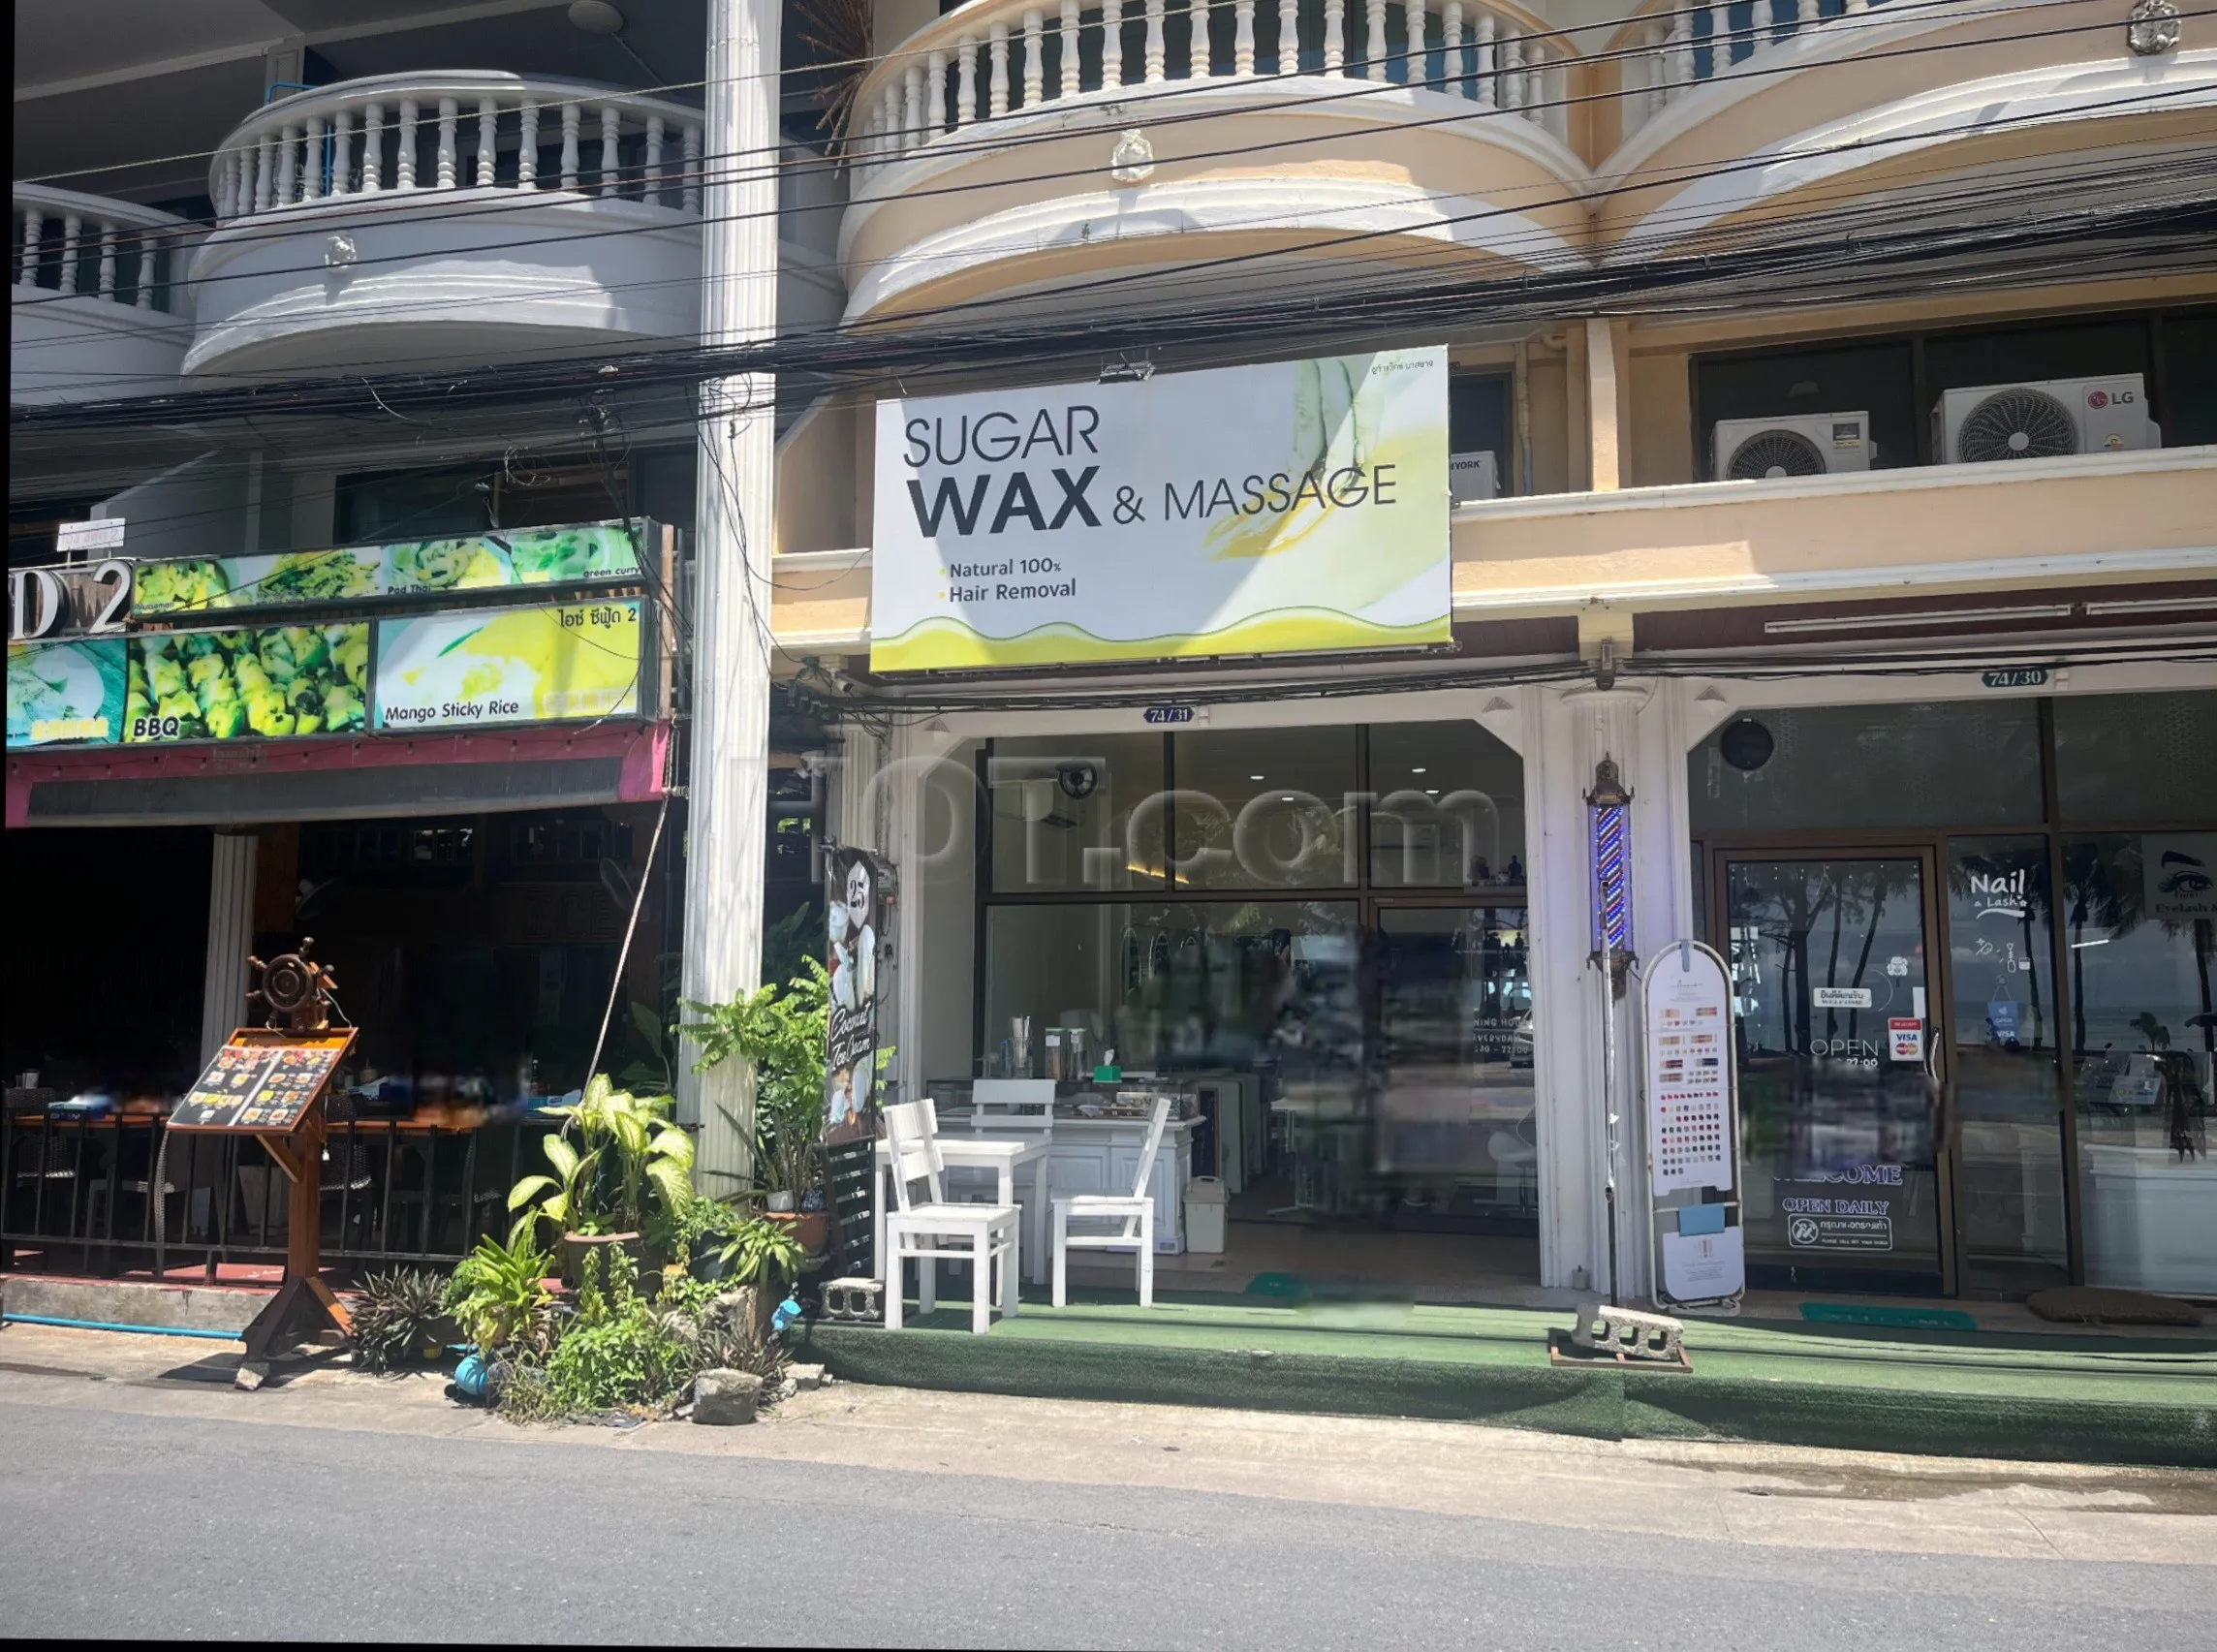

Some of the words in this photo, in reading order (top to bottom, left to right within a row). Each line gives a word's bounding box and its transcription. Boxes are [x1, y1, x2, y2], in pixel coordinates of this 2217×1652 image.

[2111, 391, 2135, 405] LG
[902, 404, 1100, 468] SUGAR
[905, 465, 1103, 539] WAX
[1112, 484, 1146, 525] &
[1165, 464, 1396, 521] MASSAGE
[583, 569, 612, 578] green
[614, 567, 640, 577] curry
[950, 558, 1014, 578] Natural
[1019, 557, 1062, 575] 100%
[89, 558, 131, 634] 2
[388, 585, 407, 596] Pad
[410, 584, 431, 595] Thai
[950, 584, 989, 603] Hair
[995, 578, 1077, 601] Removal
[627, 608, 638, 622] 2
[1988, 670, 2042, 686] 74/30
[385, 705, 436, 723] Mango
[442, 701, 484, 719] Sticky
[488, 699, 519, 715] Rice
[1150, 708, 1189, 722] 74/31
[133, 715, 180, 737] BBQ
[1971, 868, 2025, 894] Nail
[850, 879, 866, 909] 25
[1986, 894, 2018, 908] Lash
[830, 1001, 871, 1042] Coconut
[1895, 1033, 1918, 1042] VISA
[1810, 1039, 1879, 1057] OPEN
[1782, 1197, 1831, 1214] OPEN
[1835, 1200, 1890, 1216] DAILY
